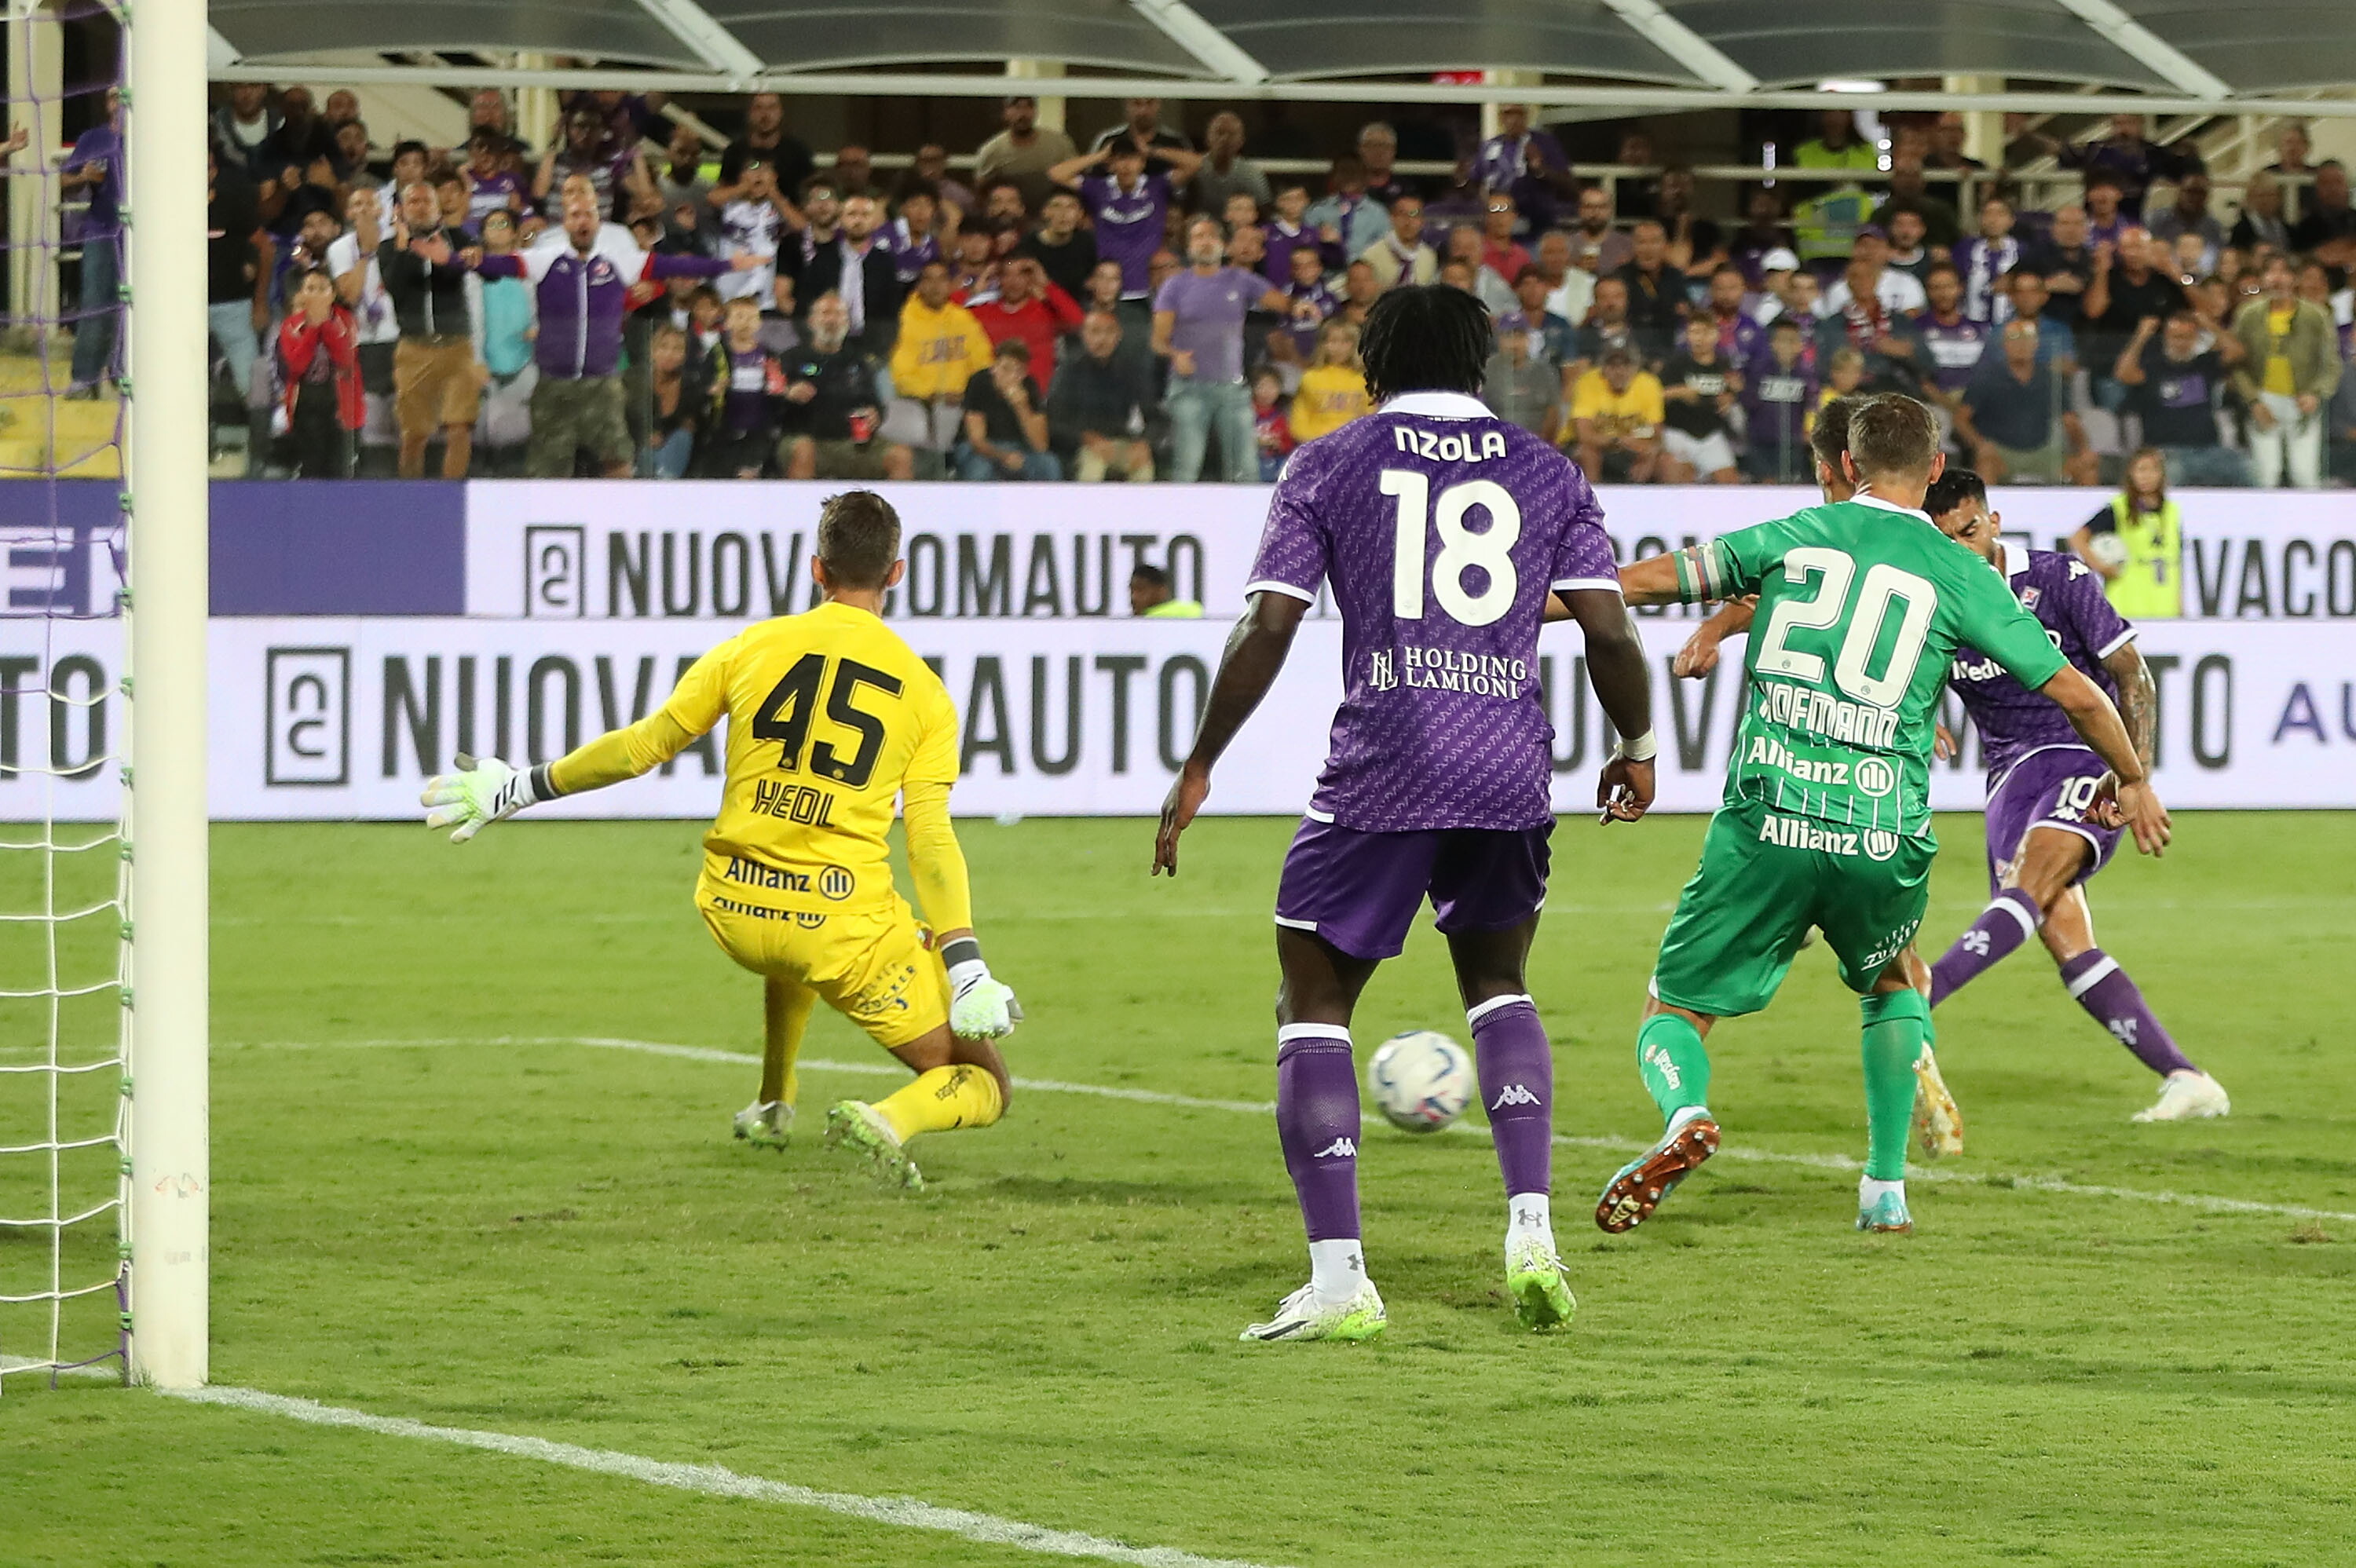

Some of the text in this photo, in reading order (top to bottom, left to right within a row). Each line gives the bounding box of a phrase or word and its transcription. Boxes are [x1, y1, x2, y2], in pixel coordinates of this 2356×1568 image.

[1379, 469, 1522, 627] 18
[608, 530, 1205, 616] NUOVOMAUTO
[1754, 546, 1938, 711] 20
[1405, 645, 1527, 681] HOLDING
[1405, 667, 1519, 700] LAMIONI
[752, 652, 905, 791] 45
[1747, 736, 1850, 785] Allianz
[751, 779, 836, 828] HEDL
[2055, 776, 2103, 811] 10
[1759, 814, 1860, 857] Allianz
[723, 857, 811, 893] Allianz
